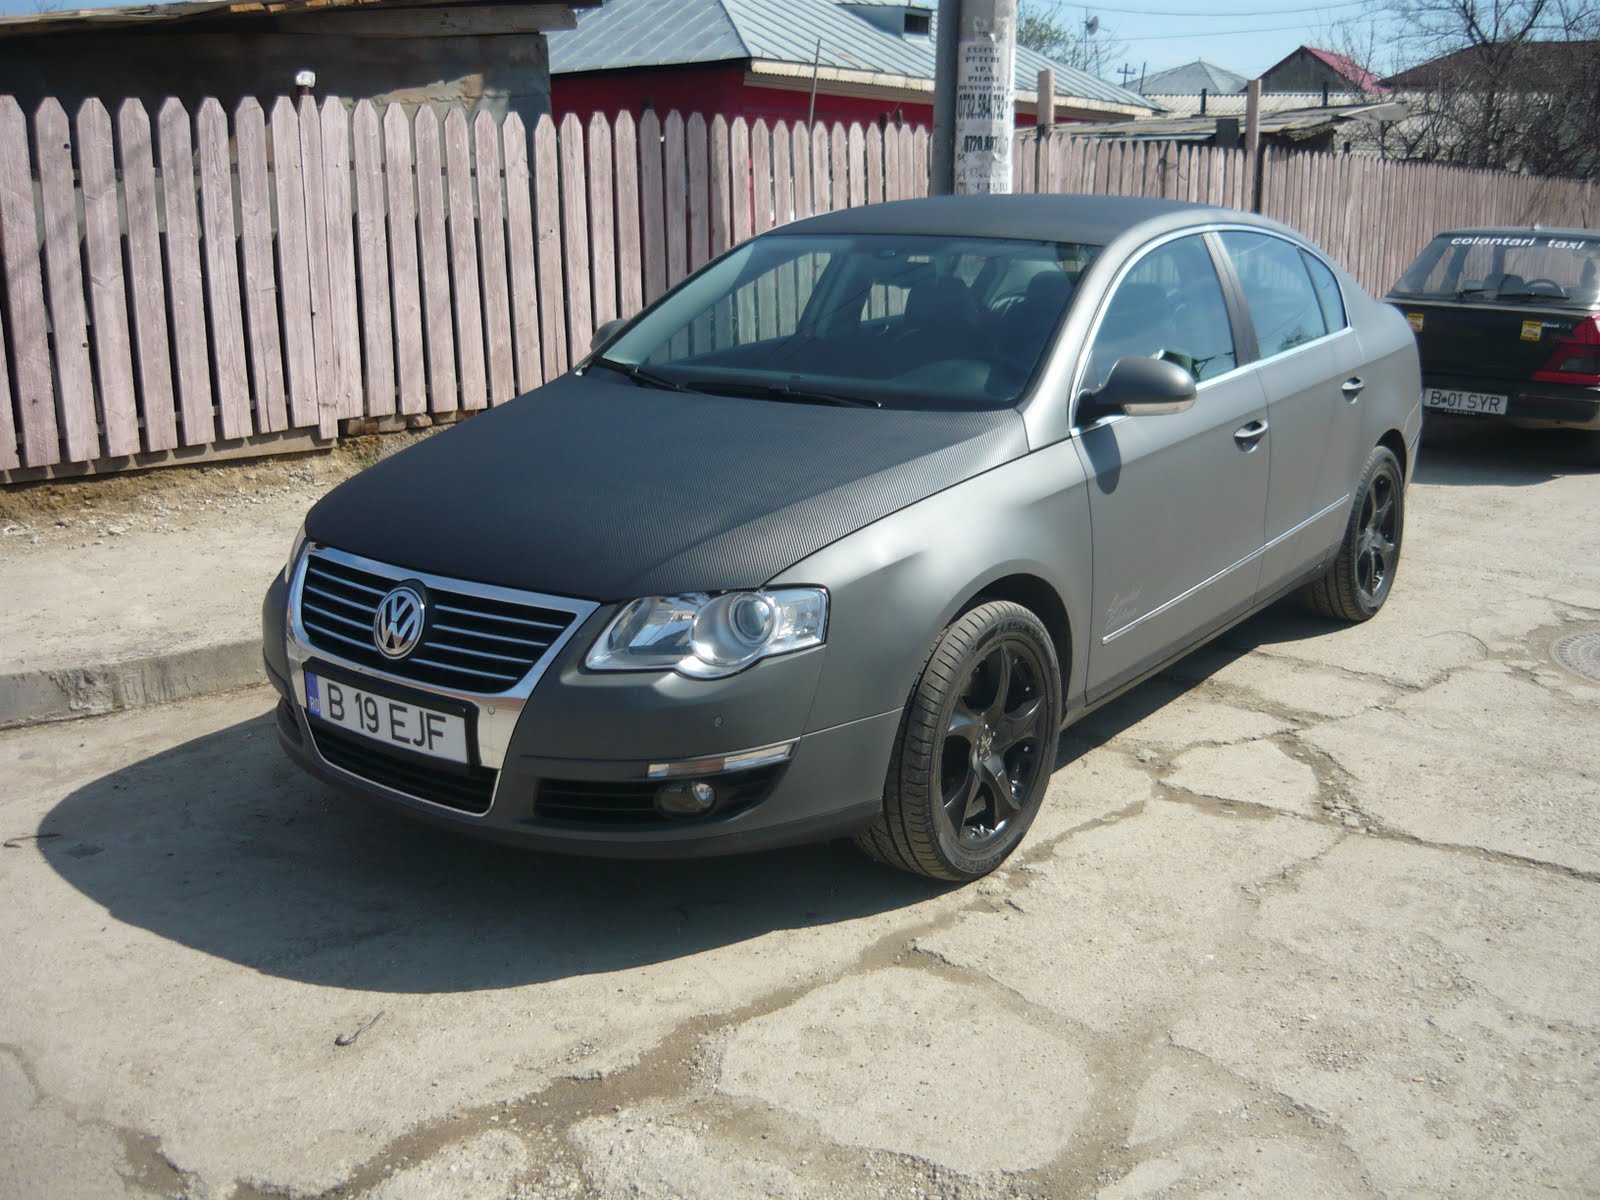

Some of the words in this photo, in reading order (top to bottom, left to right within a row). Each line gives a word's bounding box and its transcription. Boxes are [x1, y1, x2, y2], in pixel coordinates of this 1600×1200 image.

[1450, 236, 1536, 247] colantari
[1546, 238, 1586, 250] taxi
[1429, 390, 1442, 406] B
[1447, 392, 1463, 408] 01
[1467, 394, 1501, 412] SYR
[309, 695, 321, 713] RO
[327, 682, 345, 721] B
[354, 692, 380, 734] 19
[388, 703, 447, 751] EJF
